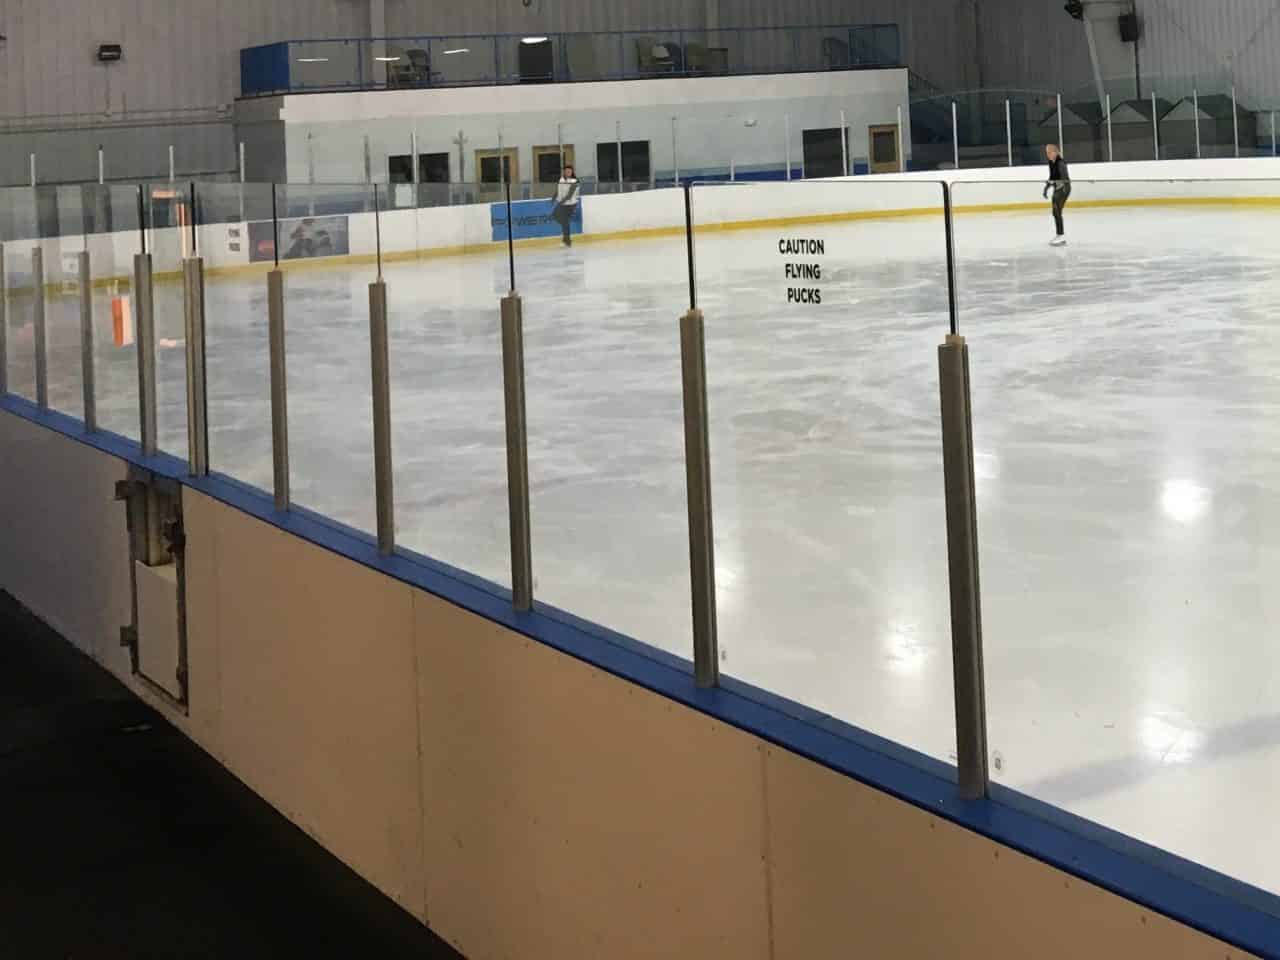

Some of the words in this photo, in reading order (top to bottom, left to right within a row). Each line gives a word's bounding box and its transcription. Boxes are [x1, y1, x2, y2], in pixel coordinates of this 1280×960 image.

[778, 239, 825, 254] CAUTION
[785, 263, 821, 279] FLYING
[787, 287, 822, 304] PUCKS
